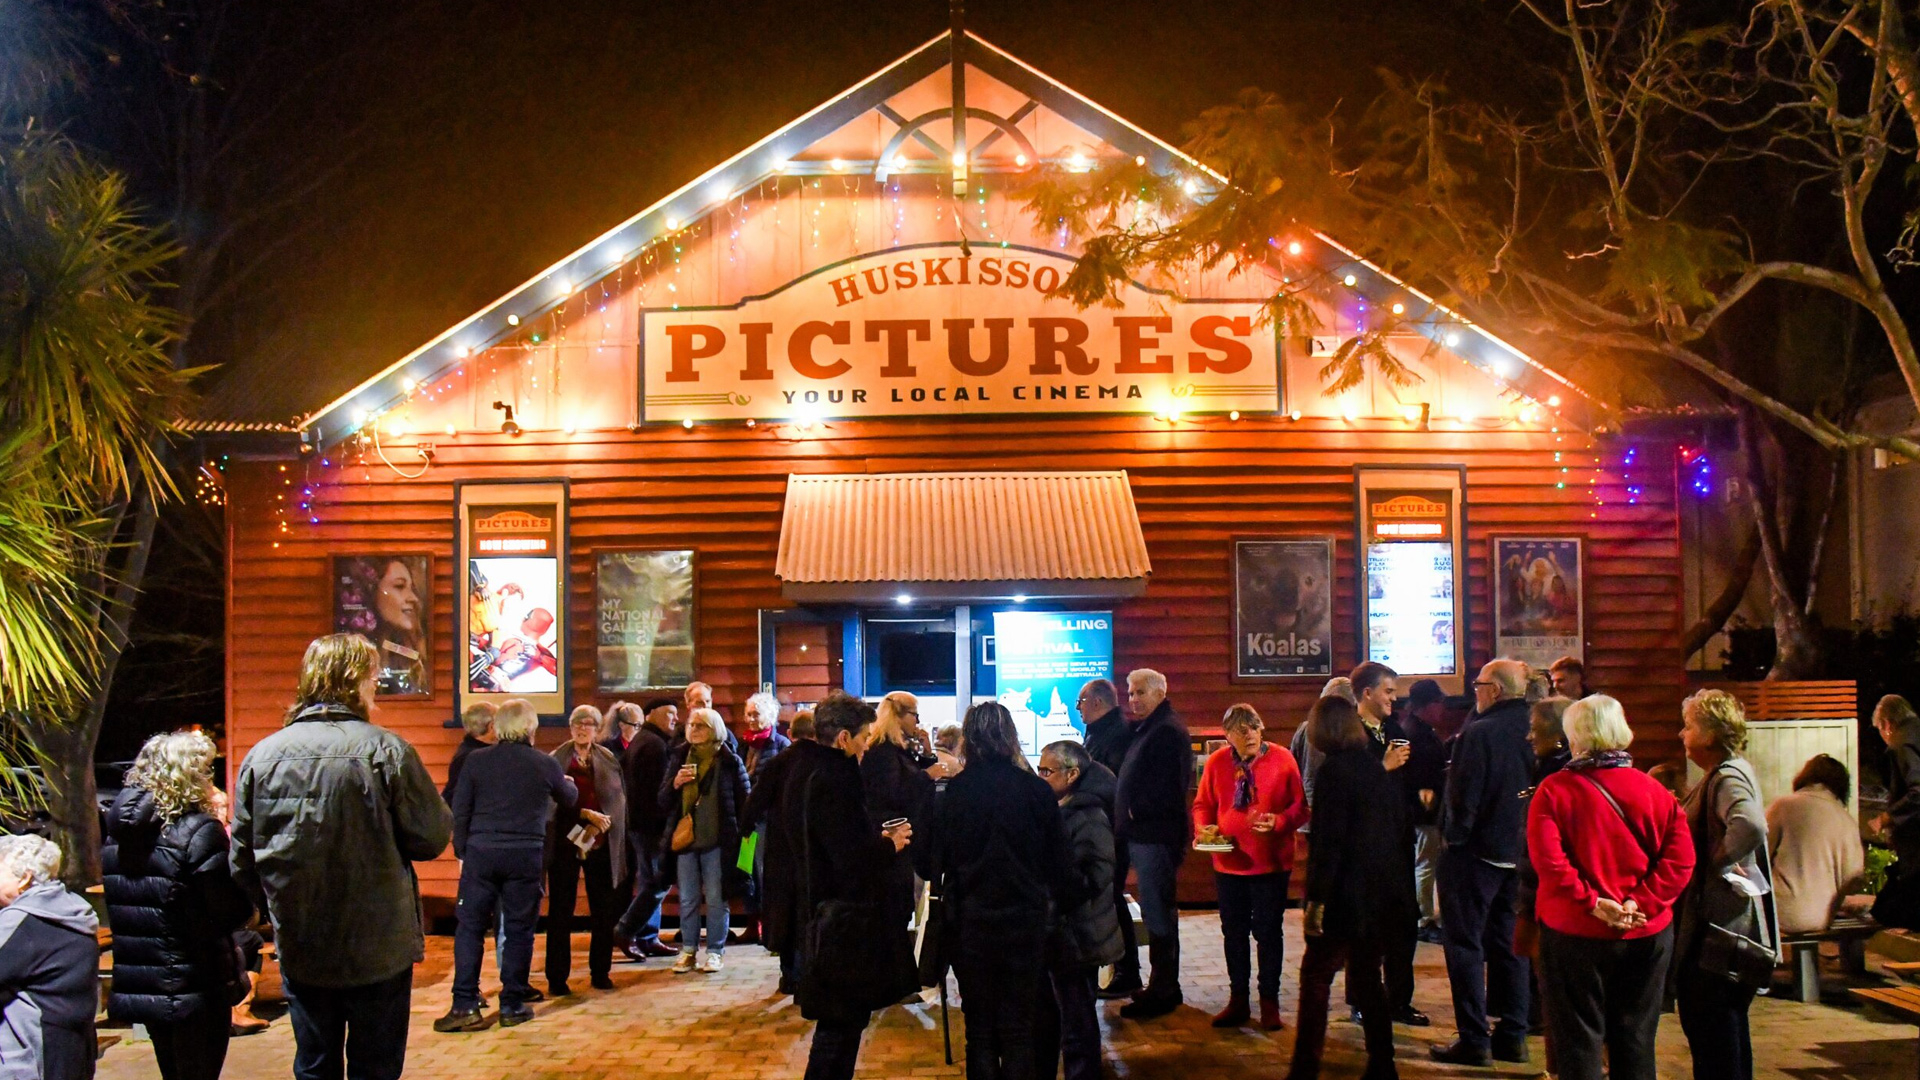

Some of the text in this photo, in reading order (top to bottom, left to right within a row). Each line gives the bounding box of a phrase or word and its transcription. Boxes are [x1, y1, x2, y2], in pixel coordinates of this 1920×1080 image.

[828, 257, 1071, 308] HUSKISSO
[665, 315, 1253, 383] PICTURES
[783, 383, 1144, 405] YOUR LOCAL CINEMA
[1375, 504, 1443, 513] PICTURES
[478, 519, 548, 528] PICTURES
[602, 598, 622, 609] MY
[602, 610, 667, 621] NATIONAL
[601, 622, 659, 633] GALLERY
[602, 634, 651, 644] LONDN
[1247, 632, 1322, 656] Koalas
